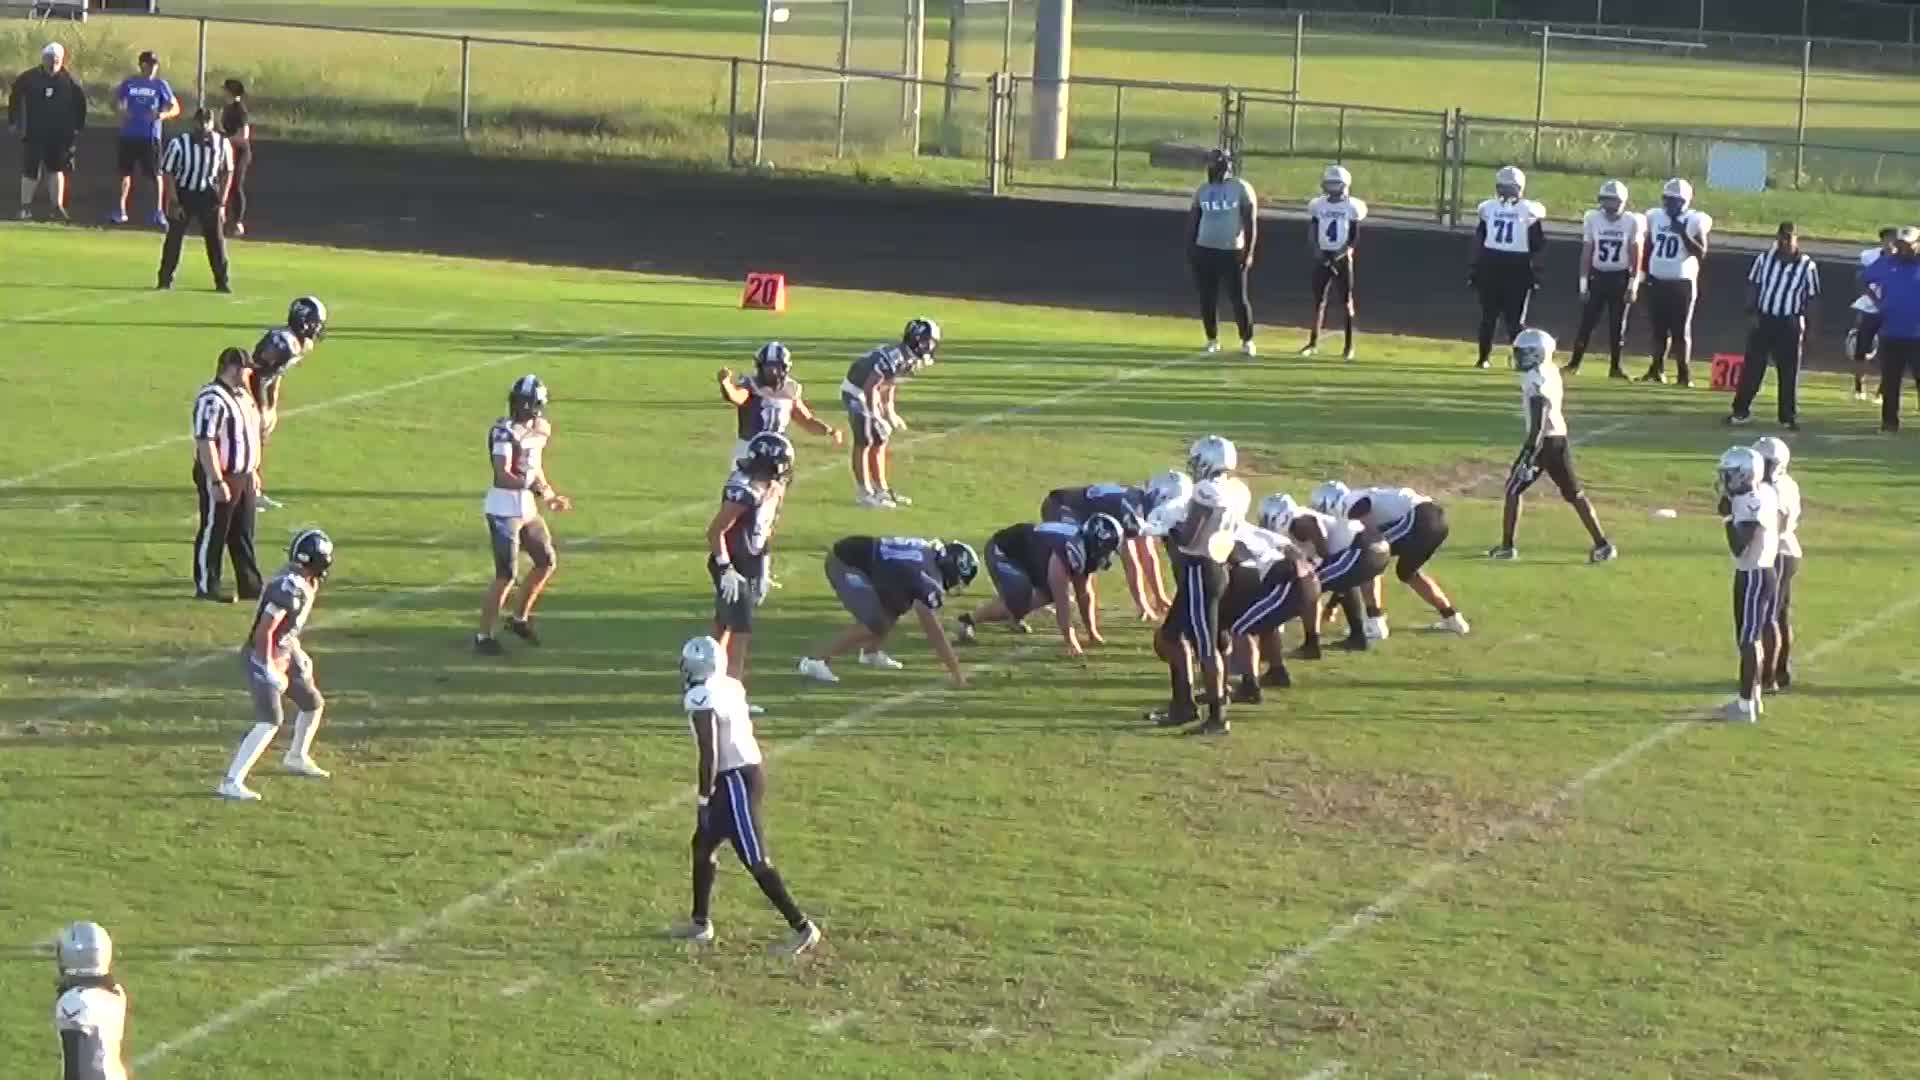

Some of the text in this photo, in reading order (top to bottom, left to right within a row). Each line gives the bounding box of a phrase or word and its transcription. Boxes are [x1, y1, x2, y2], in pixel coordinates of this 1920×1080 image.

[1325, 219, 1338, 242] 4
[1494, 220, 1513, 244] 71
[1599, 239, 1623, 262] 57
[1656, 233, 1679, 258] 70
[745, 277, 777, 306] 20
